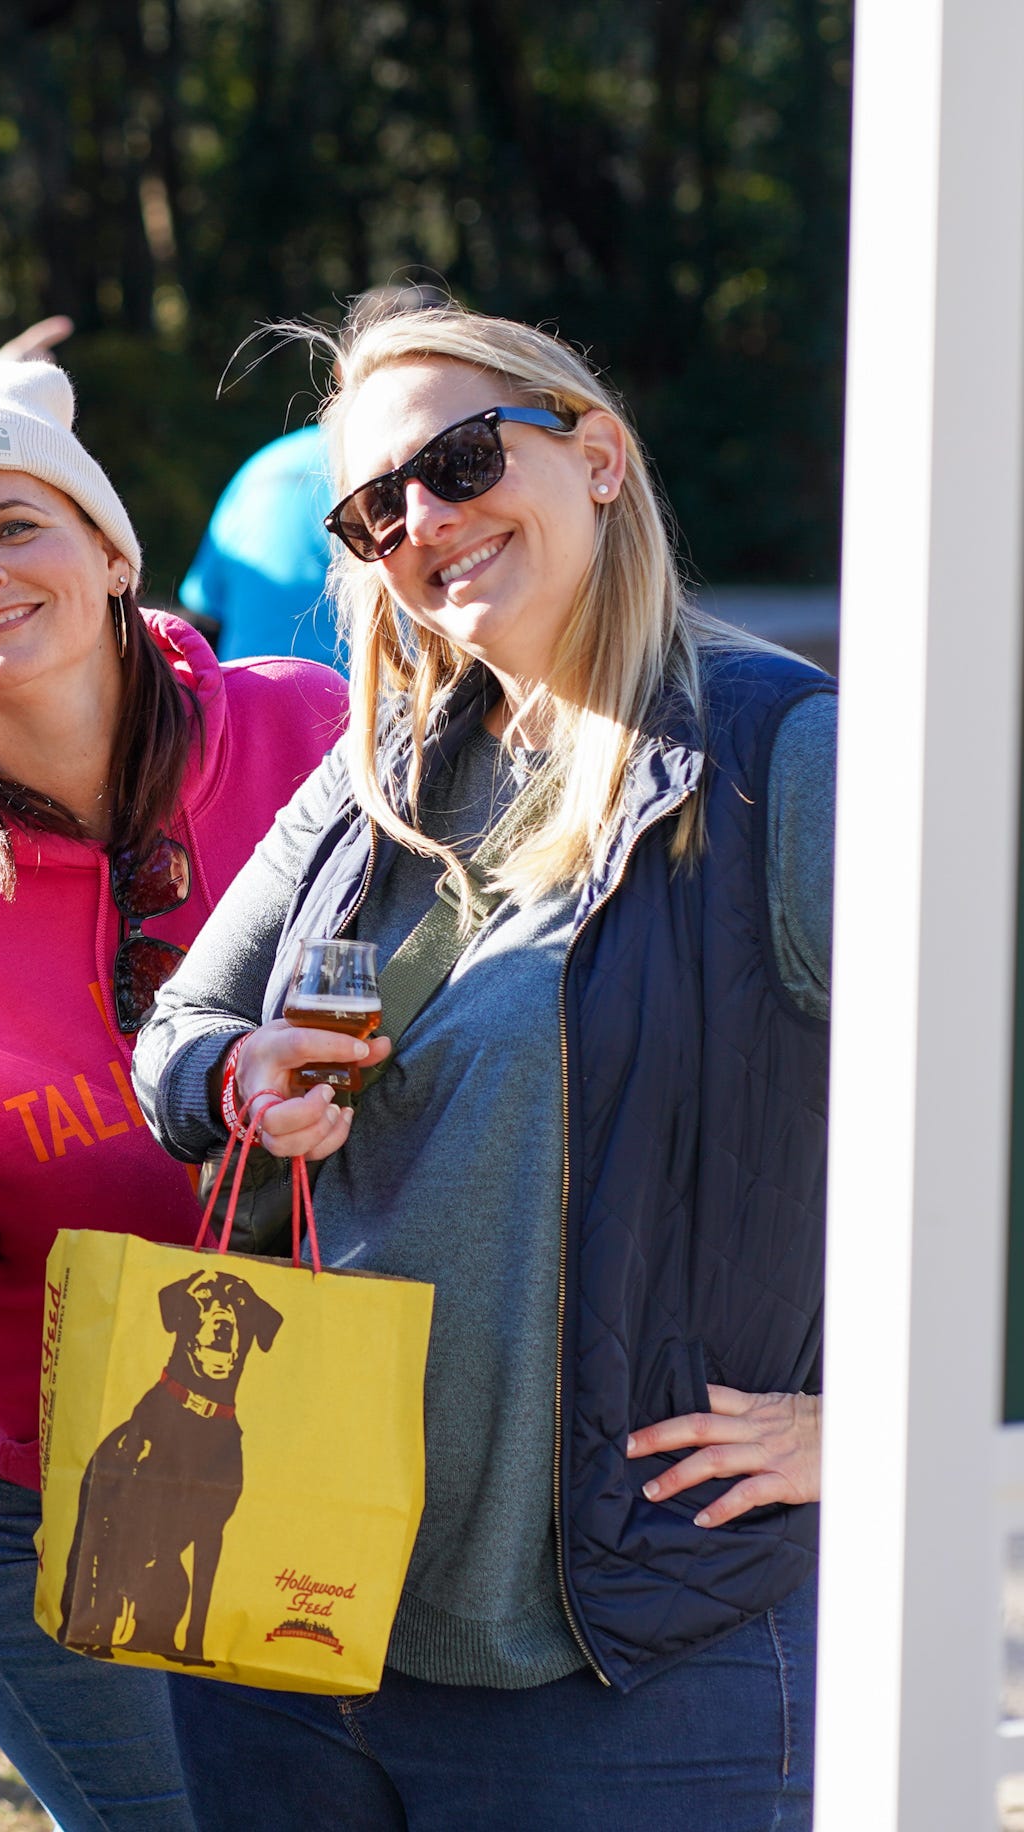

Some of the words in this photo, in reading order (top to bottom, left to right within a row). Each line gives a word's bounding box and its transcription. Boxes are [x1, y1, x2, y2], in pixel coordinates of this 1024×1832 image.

[57, 1304, 65, 1343] SUPPLY
[274, 1567, 356, 1599] Hollywood
[286, 1592, 335, 1617] Feed
